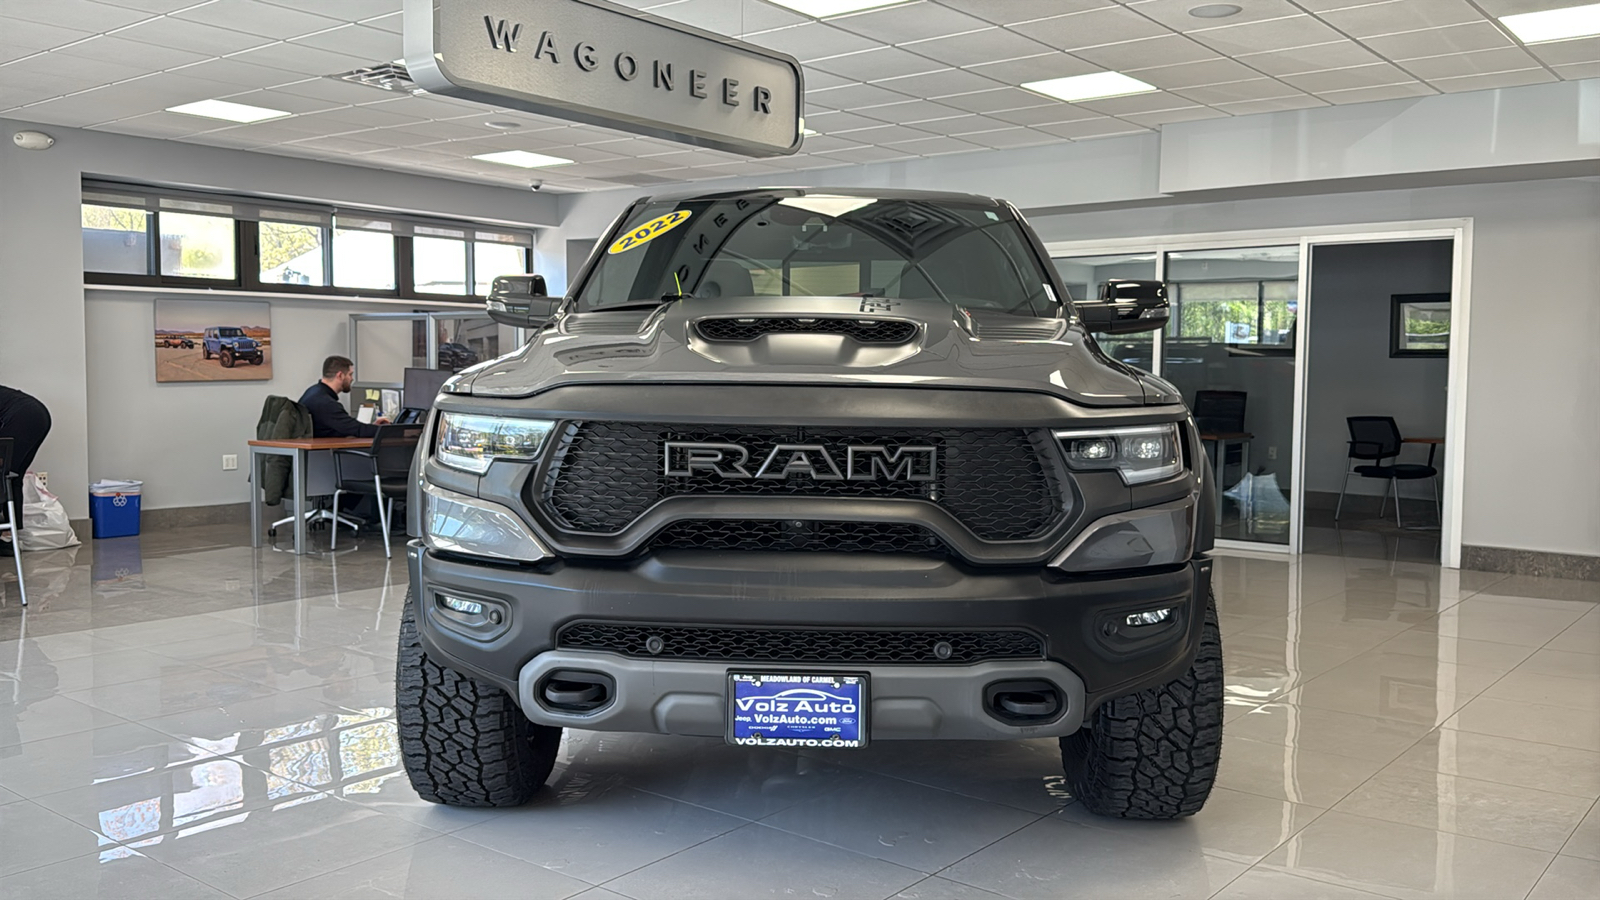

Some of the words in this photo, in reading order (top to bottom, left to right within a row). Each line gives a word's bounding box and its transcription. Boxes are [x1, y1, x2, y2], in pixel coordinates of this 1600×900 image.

[484, 15, 772, 114] WAGONEER
[619, 212, 684, 250] 2022
[664, 441, 937, 481] RAM
[760, 675, 802, 683] MEADOWLAND
[811, 676, 835, 684] CARMEL
[736, 699, 789, 712] Volz
[794, 700, 856, 713] Auto
[754, 713, 837, 725] VolzAuto.com
[735, 737, 858, 748] VOLZAUTO.COM
